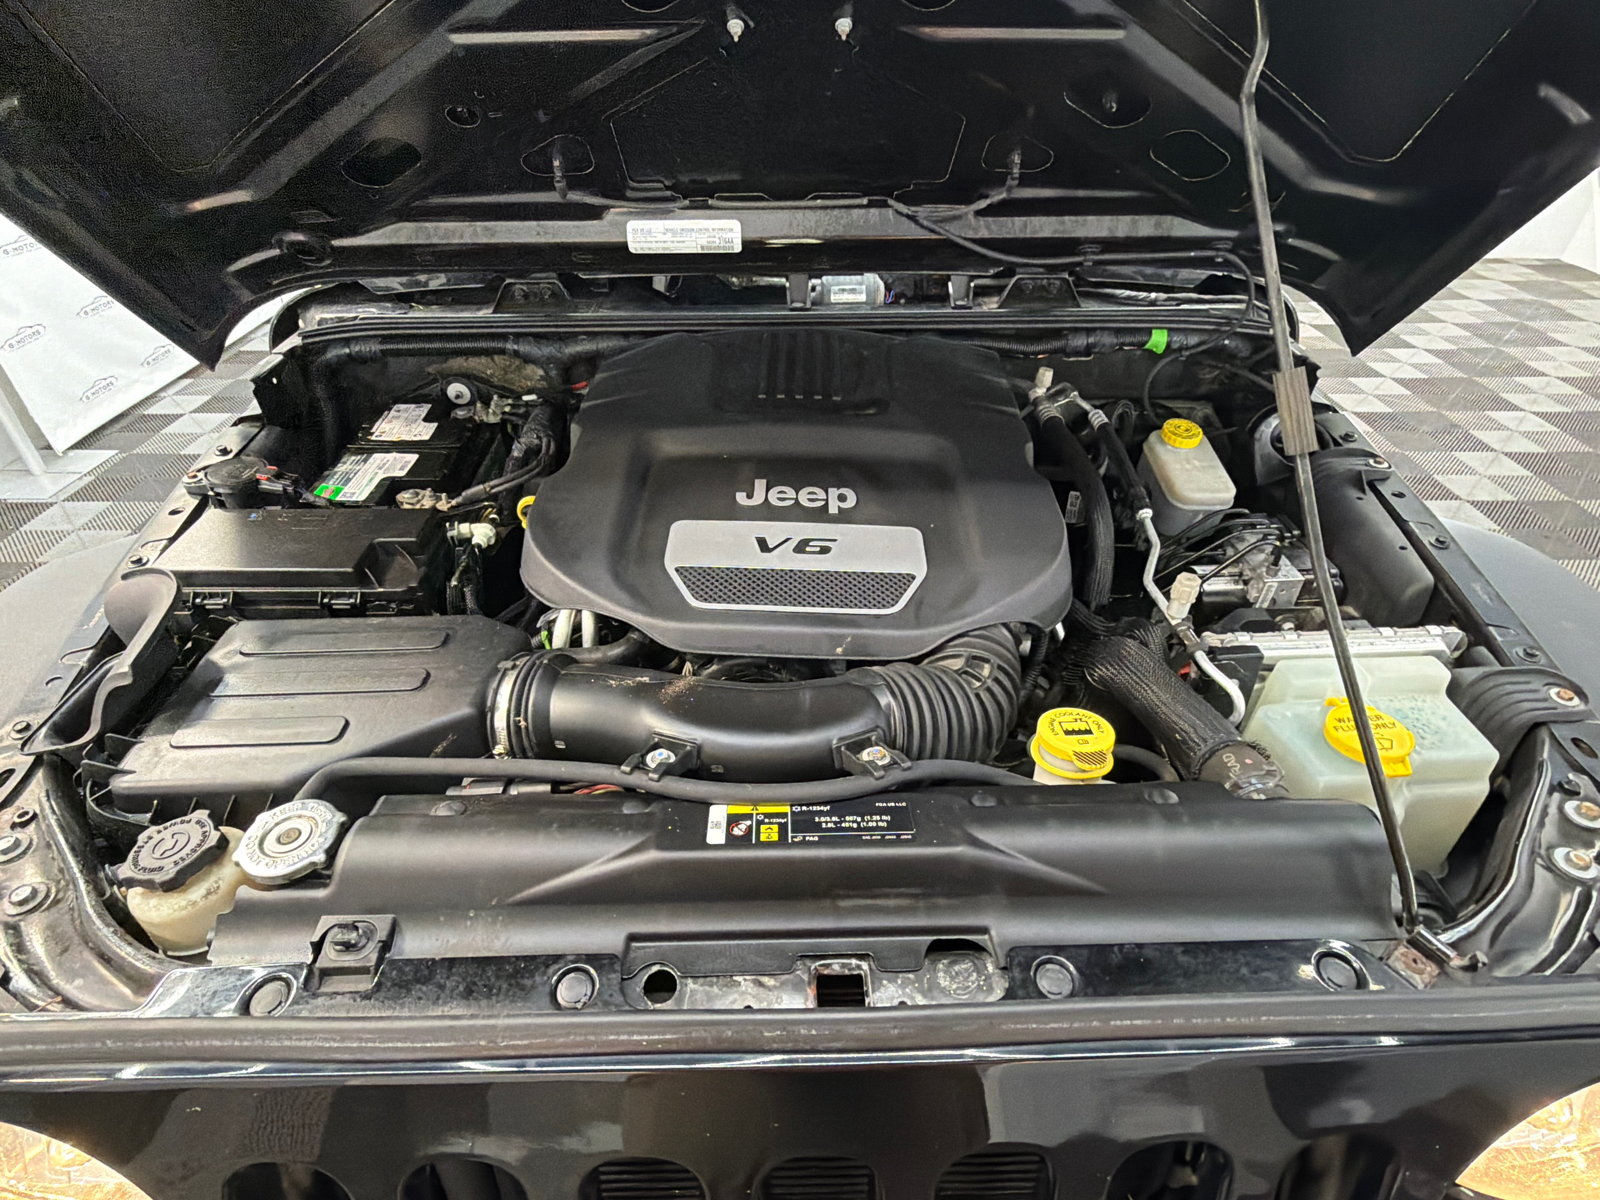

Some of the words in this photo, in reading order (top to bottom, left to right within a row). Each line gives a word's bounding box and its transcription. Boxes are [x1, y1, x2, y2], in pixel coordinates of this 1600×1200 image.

[735, 478, 857, 514] Jeep
[754, 536, 838, 555] V6
[1048, 717, 1060, 736] ENGINE
[1054, 711, 1092, 720] COOLANT
[1092, 720, 1105, 734] ONLY
[1334, 714, 1385, 724] WAER
